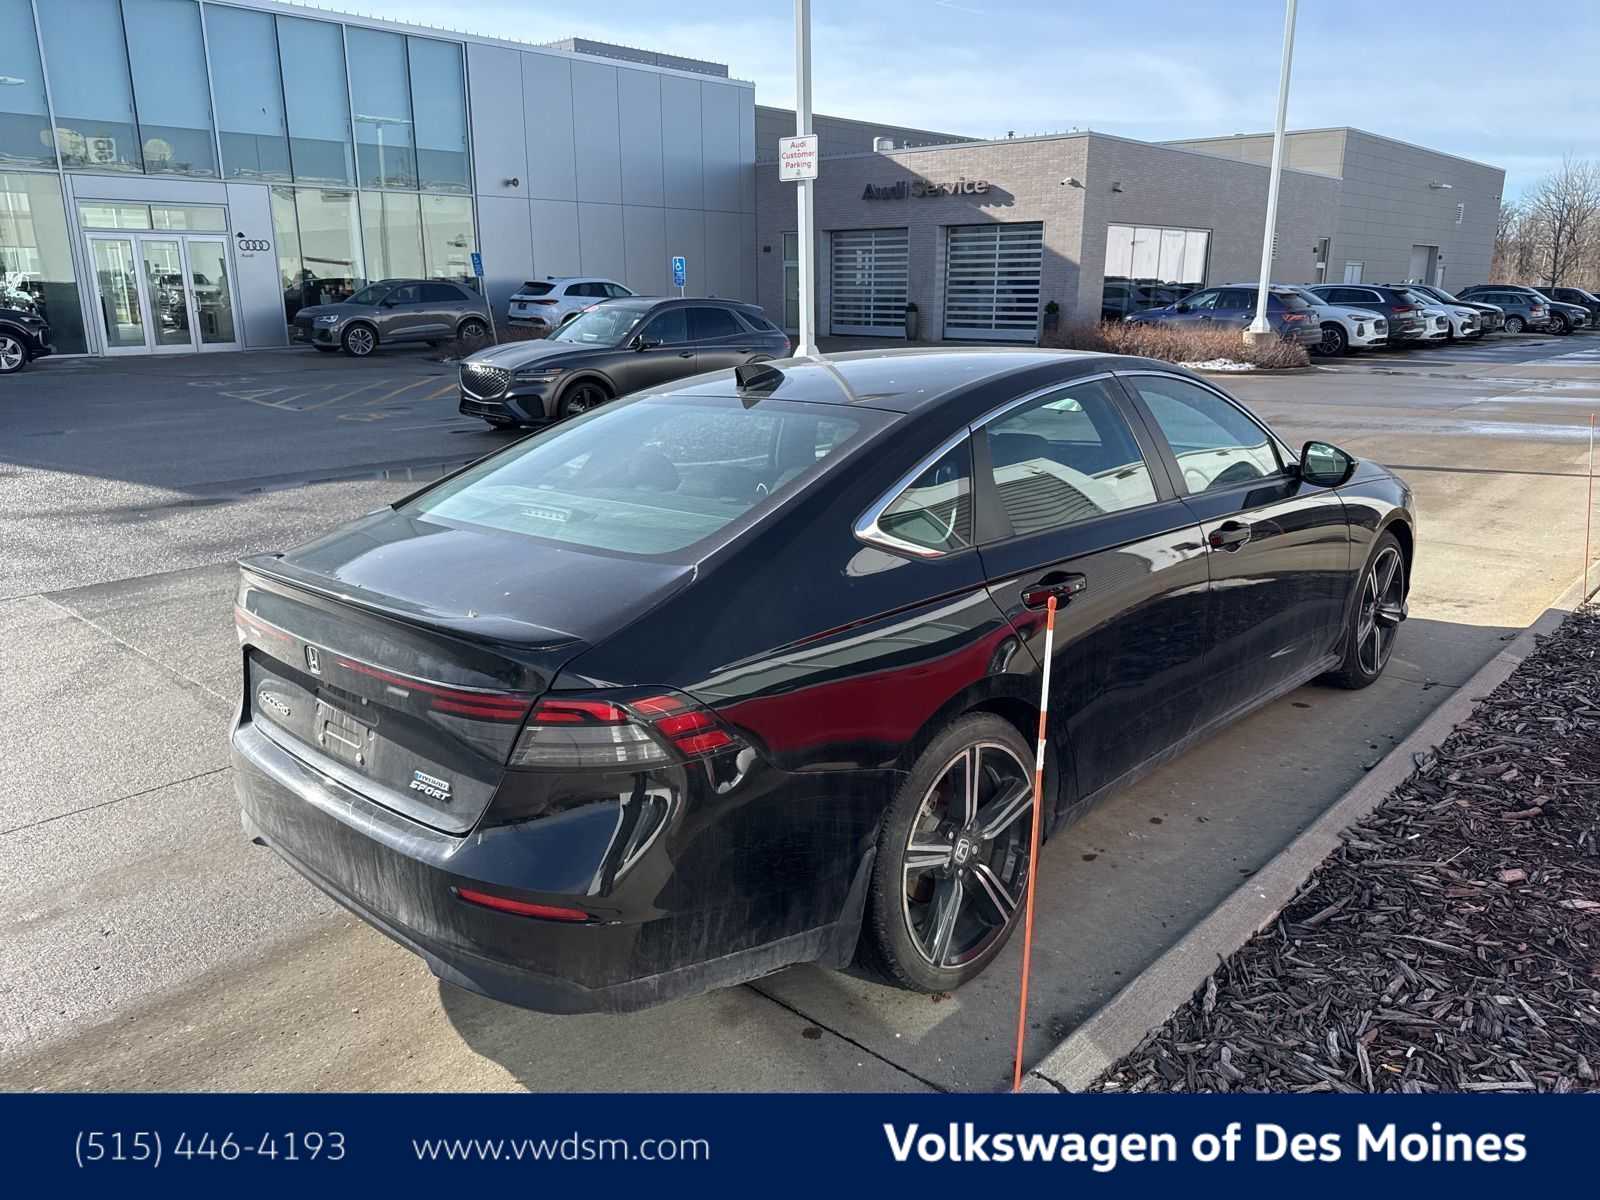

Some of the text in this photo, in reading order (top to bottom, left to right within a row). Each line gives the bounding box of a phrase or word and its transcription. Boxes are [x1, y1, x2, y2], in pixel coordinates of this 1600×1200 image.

[790, 141, 807, 149] Audi
[782, 151, 816, 160] Customer
[785, 161, 812, 169] Parking
[862, 176, 988, 200] Audi Service
[409, 780, 451, 800] SPORT
